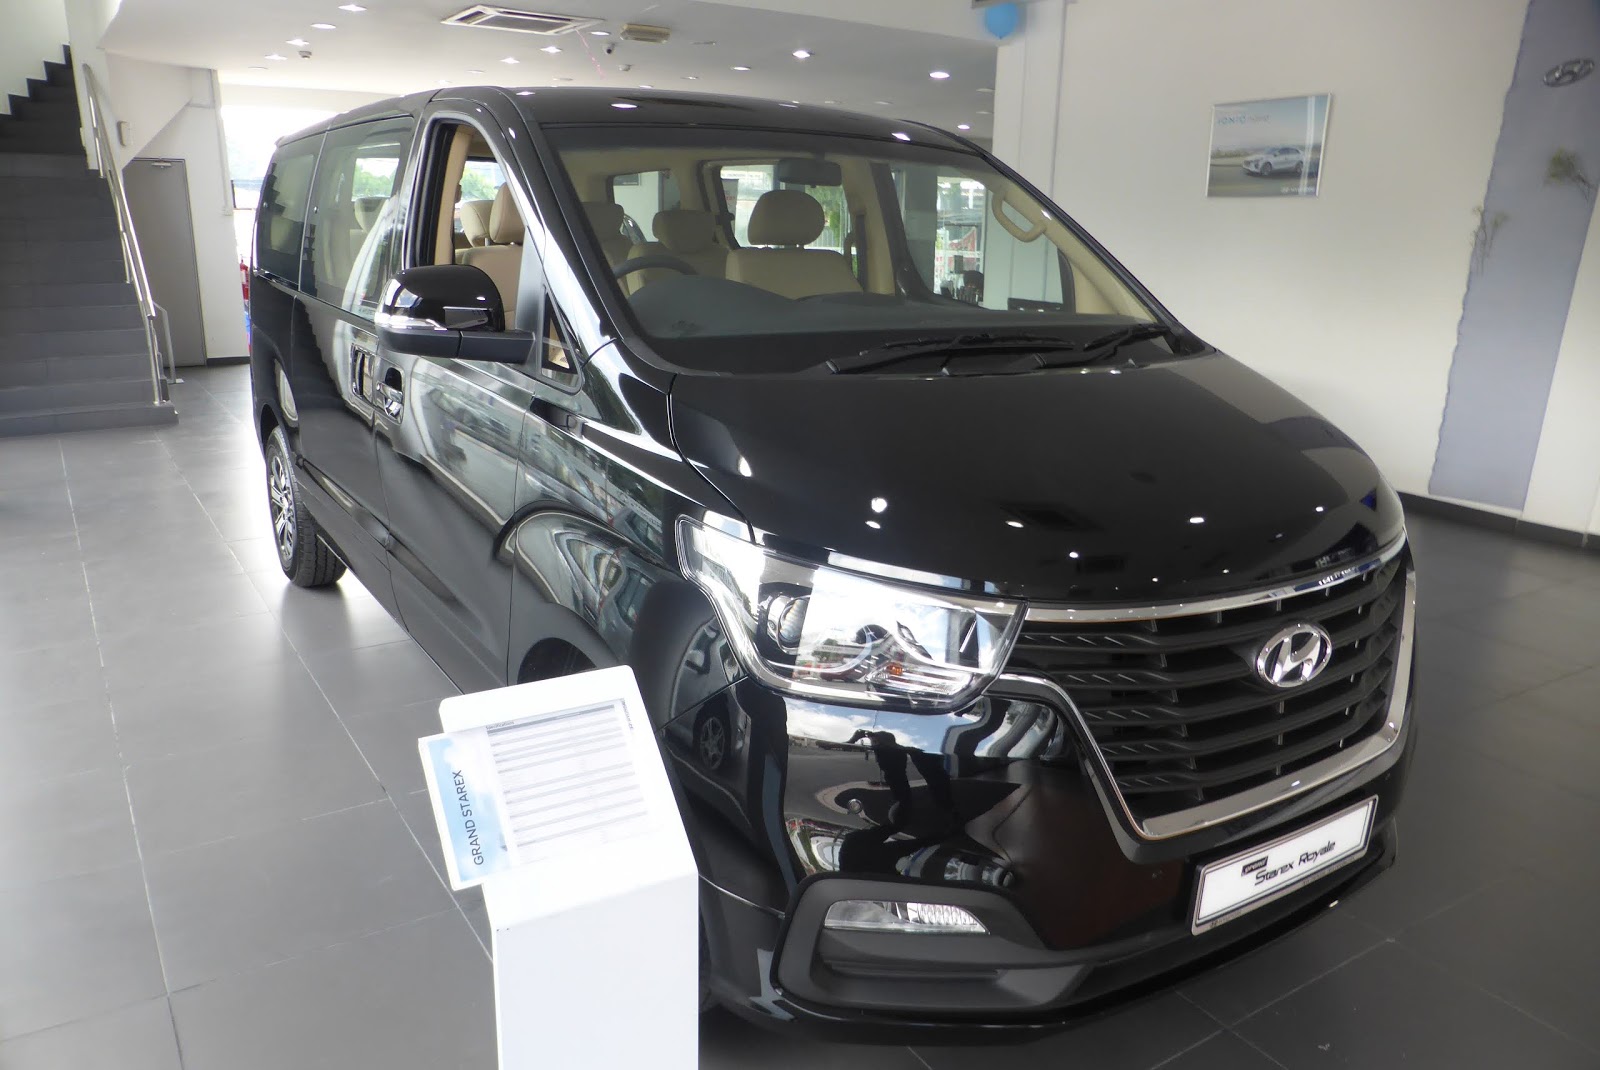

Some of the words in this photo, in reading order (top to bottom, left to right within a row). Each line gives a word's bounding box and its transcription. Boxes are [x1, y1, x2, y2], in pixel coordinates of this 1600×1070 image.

[452, 769, 473, 817] STAREX
[464, 819, 485, 866] GRAND
[1254, 861, 1294, 886] Starex
[1298, 841, 1336, 863] Royale
